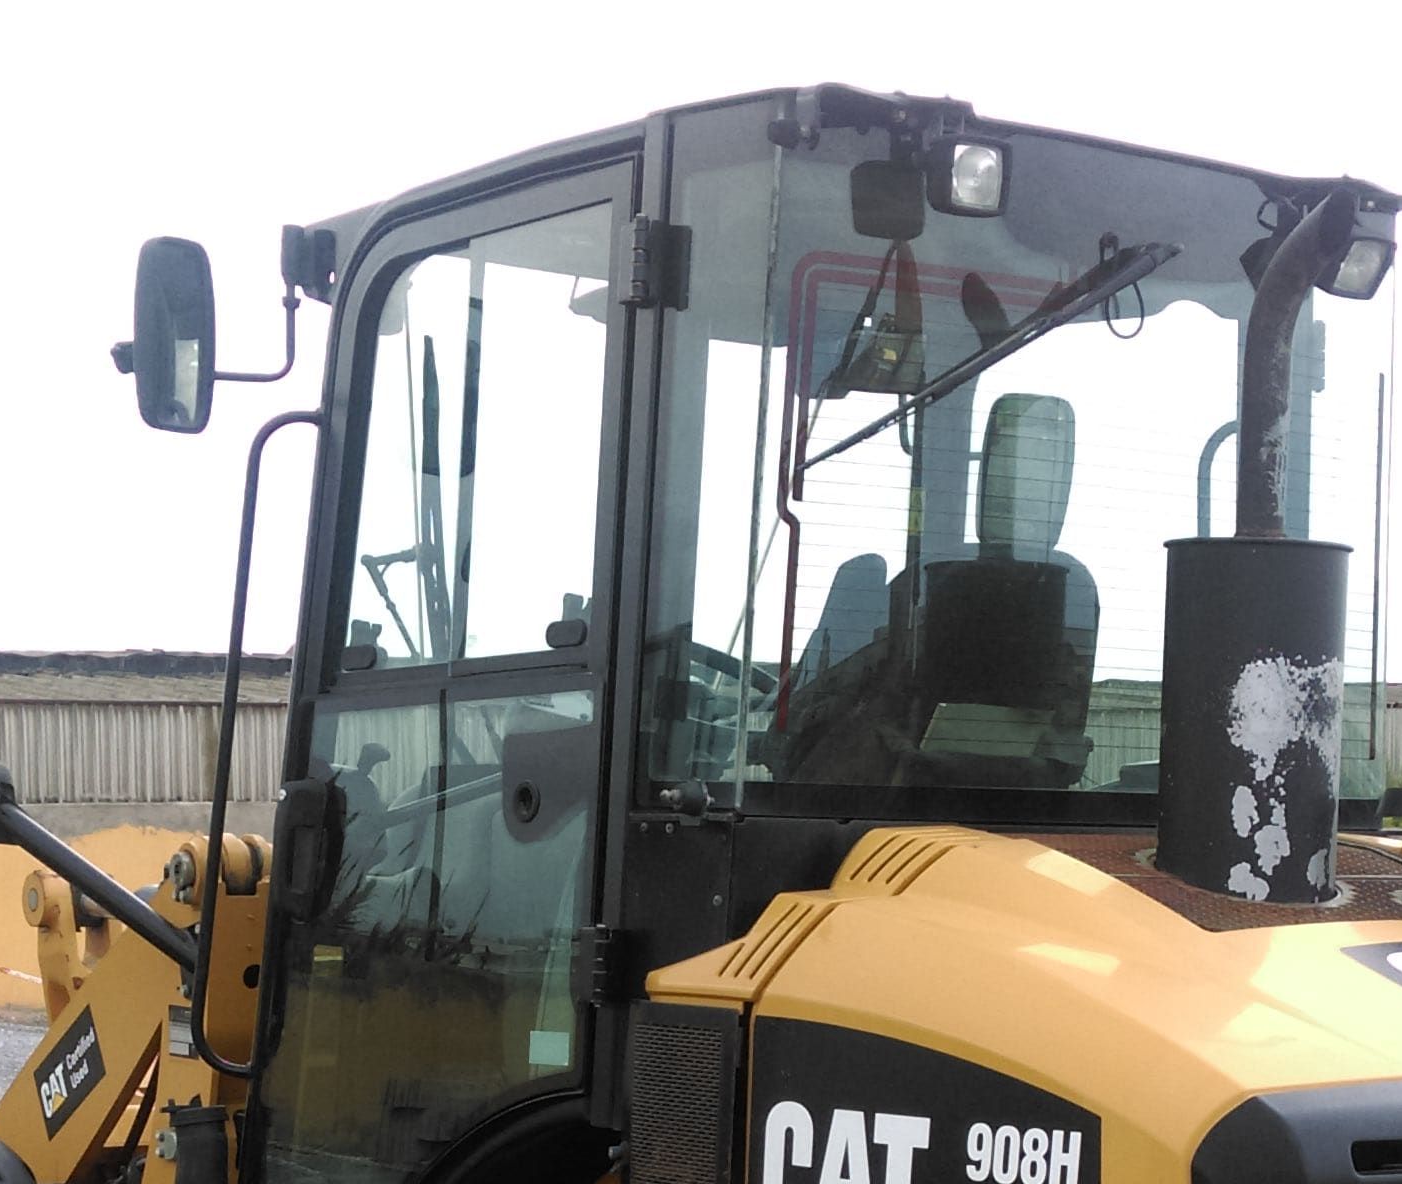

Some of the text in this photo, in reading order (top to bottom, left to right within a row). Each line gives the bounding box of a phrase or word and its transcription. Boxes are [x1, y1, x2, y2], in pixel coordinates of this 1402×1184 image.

[65, 1025, 96, 1070] Certified
[40, 1062, 69, 1119] CAT
[69, 1058, 90, 1090] Used
